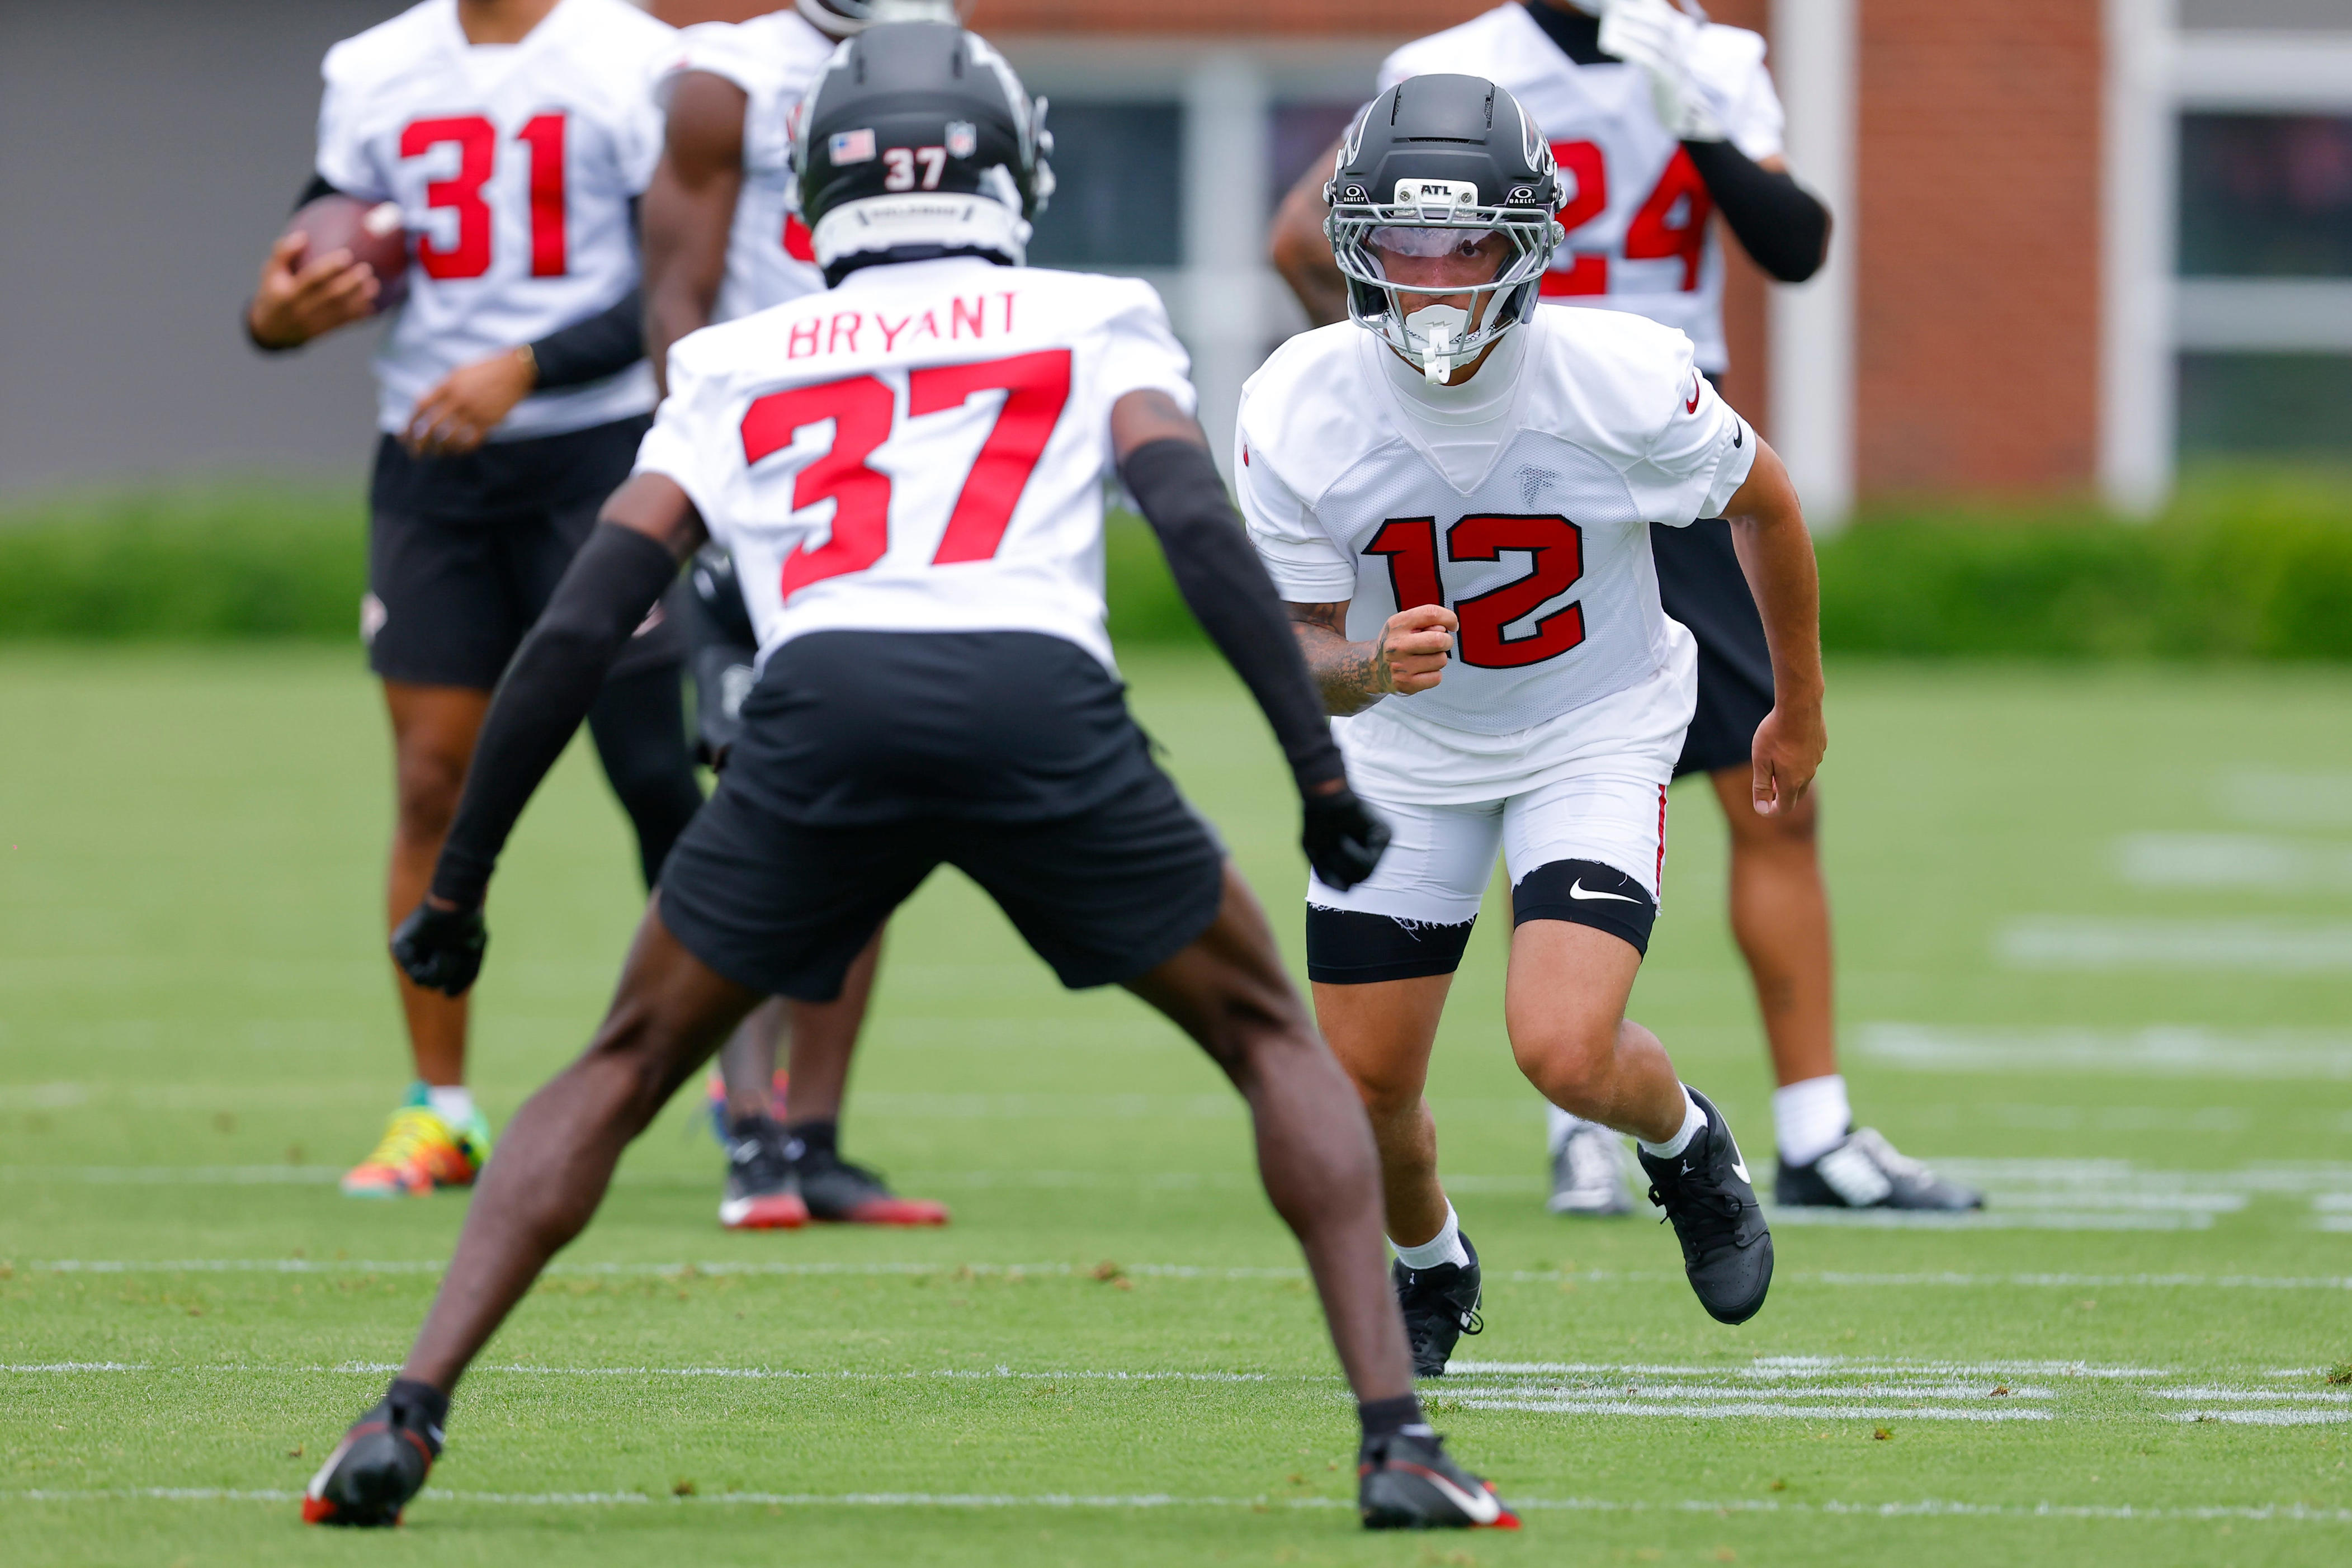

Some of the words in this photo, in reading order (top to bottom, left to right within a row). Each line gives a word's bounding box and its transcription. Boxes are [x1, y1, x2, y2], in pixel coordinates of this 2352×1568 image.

[399, 112, 568, 281] 31
[882, 145, 947, 193] 37
[1421, 185, 1452, 196] ATL
[1538, 138, 1712, 299] 24
[786, 289, 1023, 361] BRYANT
[739, 347, 1073, 610] 37
[1361, 512, 1586, 669] 12
